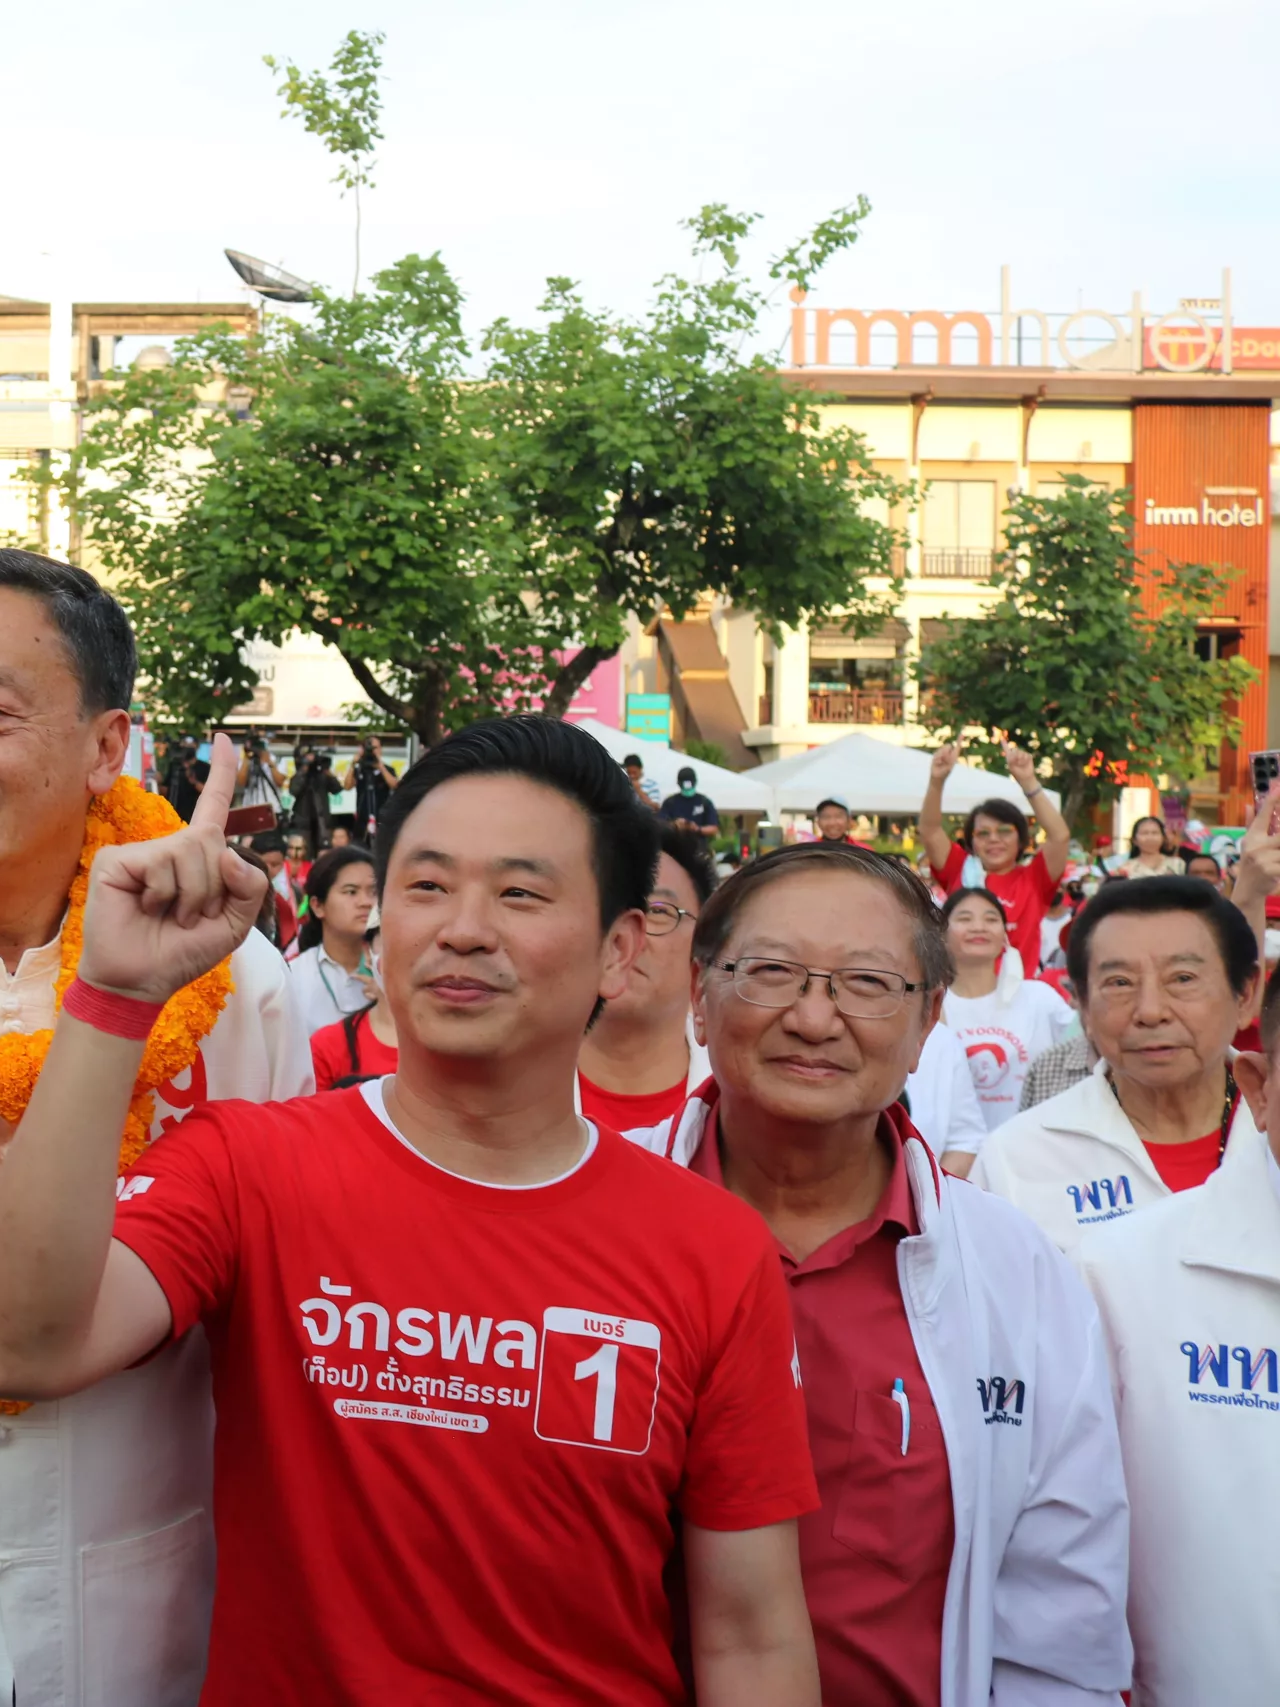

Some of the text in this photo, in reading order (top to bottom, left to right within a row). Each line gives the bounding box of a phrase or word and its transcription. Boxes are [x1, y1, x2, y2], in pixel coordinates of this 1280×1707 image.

[789, 265, 1231, 374] imm hotel
[1145, 497, 1263, 527] imm hotel
[1066, 1174, 1134, 1213] พท
[299, 1276, 537, 1370] จักรพล
[584, 1317, 626, 1338] เบอร์
[303, 1356, 531, 1408] (ท็อป) ตั้งสุทธิธรรม
[1179, 1341, 1278, 1393] พท
[574, 1343, 619, 1442] 1
[1188, 1390, 1280, 1412] พรรคเพื่อไทย
[340, 1402, 480, 1429] ผู้สมัคร ส.ส. เชียงใหม่ เขต 1
